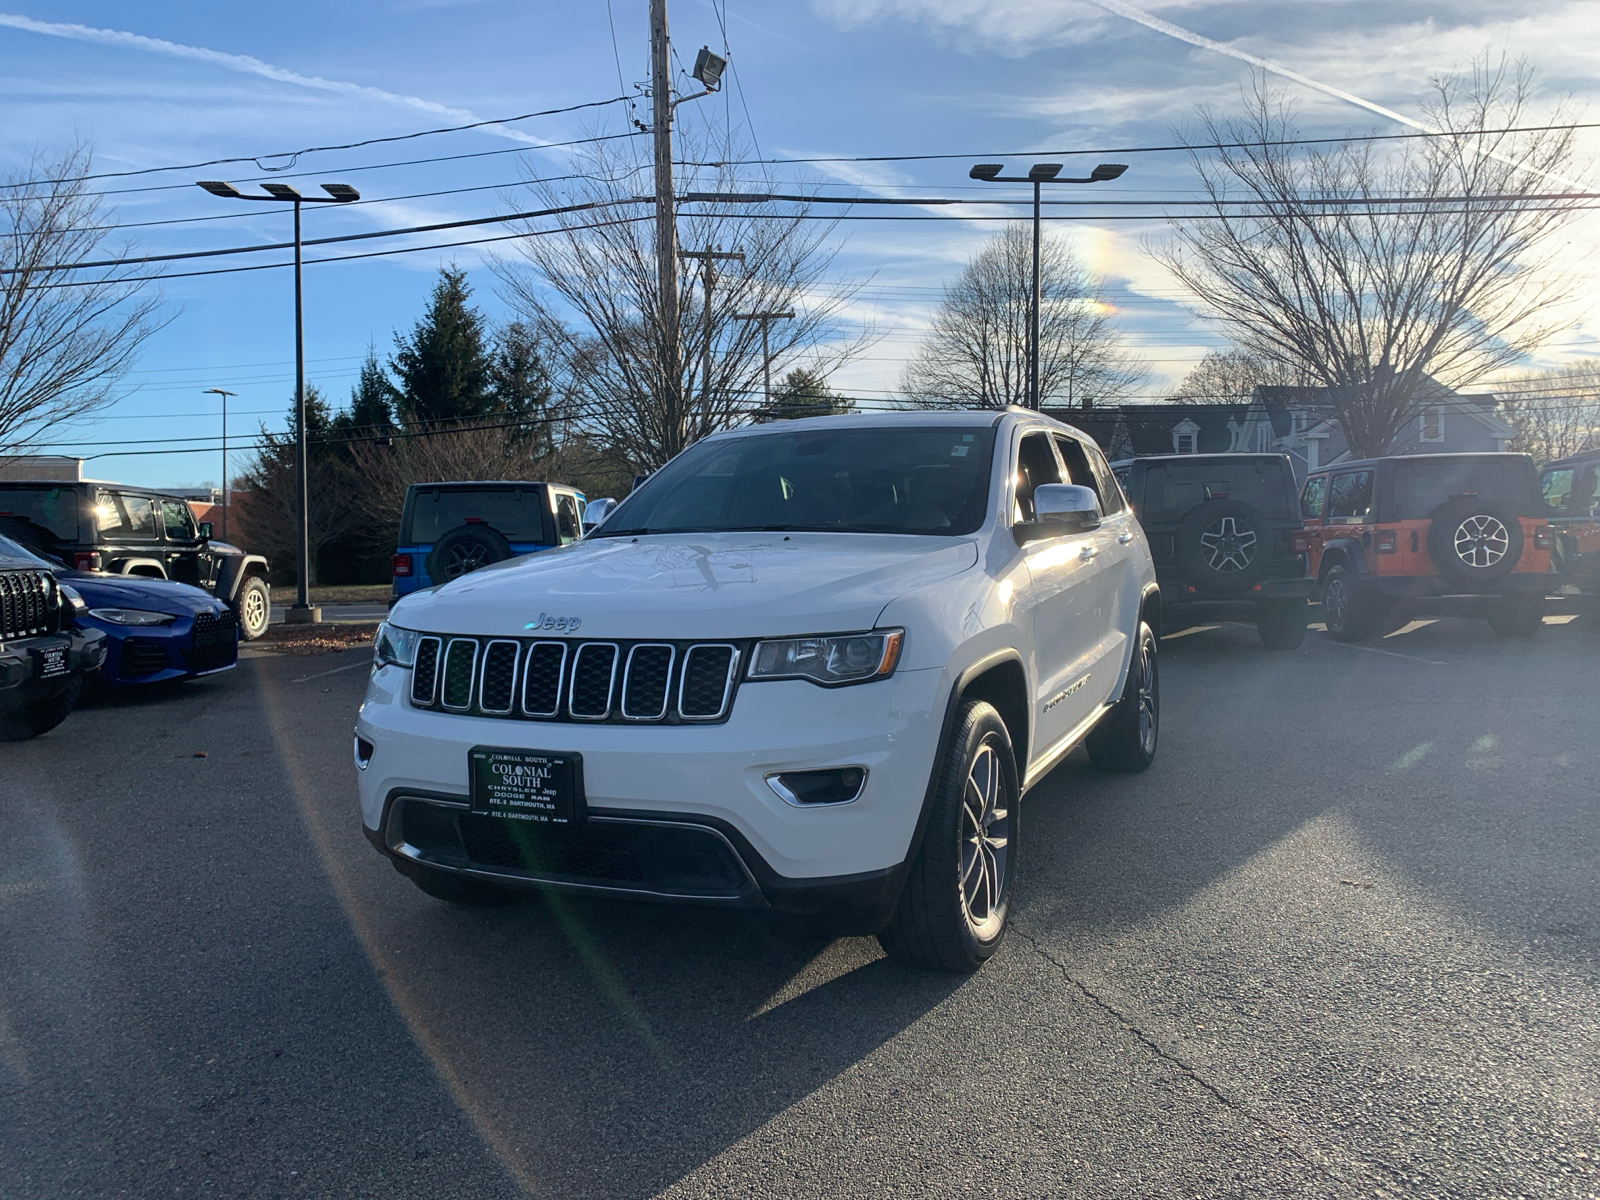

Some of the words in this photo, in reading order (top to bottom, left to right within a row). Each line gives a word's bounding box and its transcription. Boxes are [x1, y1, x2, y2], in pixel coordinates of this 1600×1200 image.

[528, 612, 581, 634] Jeep
[491, 754, 522, 762] COLONIAL
[492, 763, 551, 778] COLONIAL
[503, 775, 541, 788] SOUTH
[488, 785, 537, 793] CHRYSLER
[542, 787, 557, 796] Jeep
[494, 791, 525, 799] DODGE
[509, 800, 546, 809] DARTMOUTH,
[508, 813, 540, 822] DARTMOUTH,
